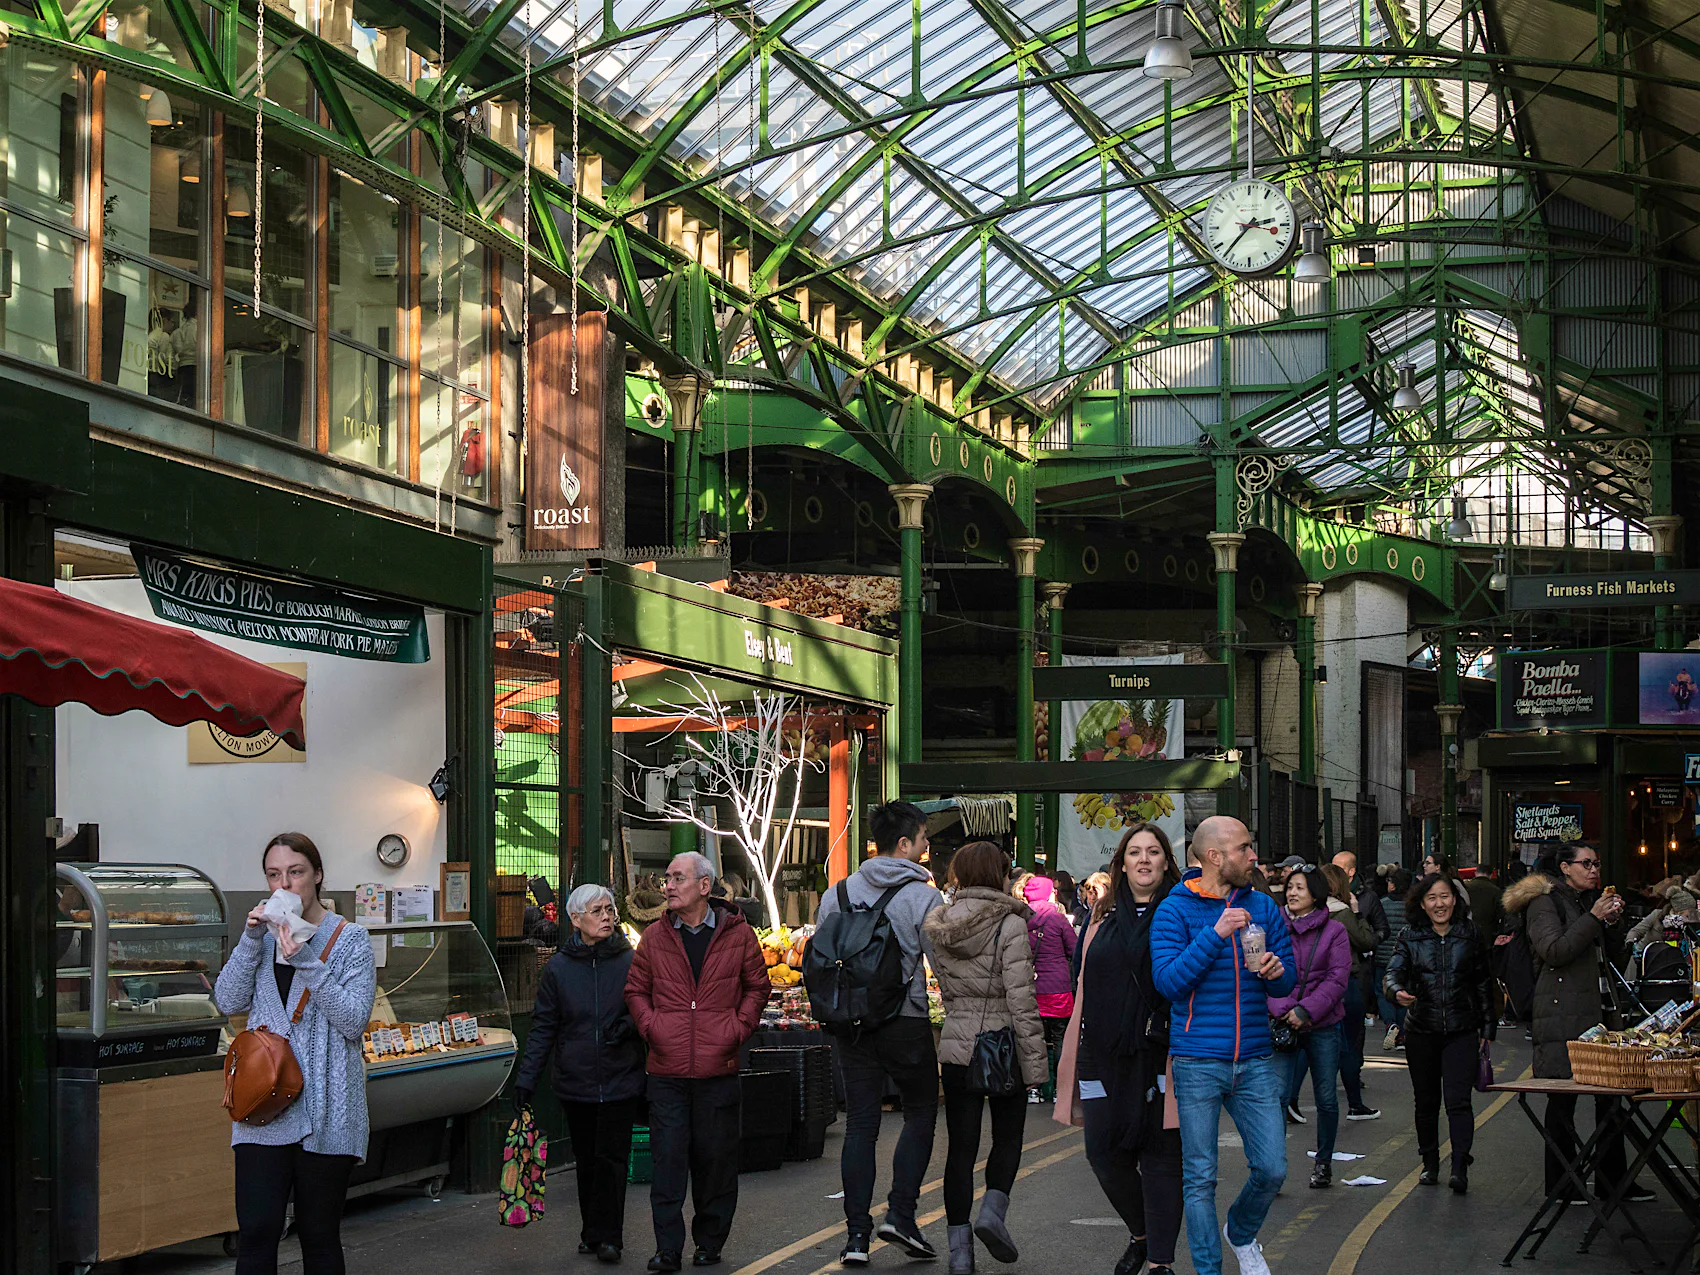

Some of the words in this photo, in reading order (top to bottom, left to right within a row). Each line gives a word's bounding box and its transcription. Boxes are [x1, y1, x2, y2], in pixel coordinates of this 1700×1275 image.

[343, 415, 382, 448] roast
[533, 504, 591, 525] roast
[144, 555, 181, 592] MRS
[181, 570, 236, 605] KINGS
[240, 580, 273, 613] PIES
[275, 601, 285, 614] OF
[286, 600, 333, 619] BOROUGH
[1546, 583, 1593, 597] Furness
[1597, 581, 1622, 595] Fish
[1626, 580, 1676, 594] Markets
[161, 598, 193, 623] AWARD
[191, 609, 237, 635] WINNING
[237, 619, 280, 641] MELTON
[279, 626, 330, 646] MOWBRAY
[330, 631, 355, 651] PORK
[356, 635, 372, 653] PIE
[744, 630, 765, 663] Elsey
[766, 635, 775, 661] &
[774, 637, 793, 666] Bent
[1522, 660, 1580, 679] Bomba
[1108, 673, 1151, 690] Turnips
[1515, 804, 1561, 819] Shetlands
[1515, 818, 1534, 830] Salt
[1534, 817, 1541, 828] &
[1542, 815, 1575, 828] Pepper
[1514, 828, 1537, 842] Chilli
[1537, 825, 1564, 840] Squid
[98, 1044, 115, 1058] HOT
[165, 1037, 180, 1050] HOT
